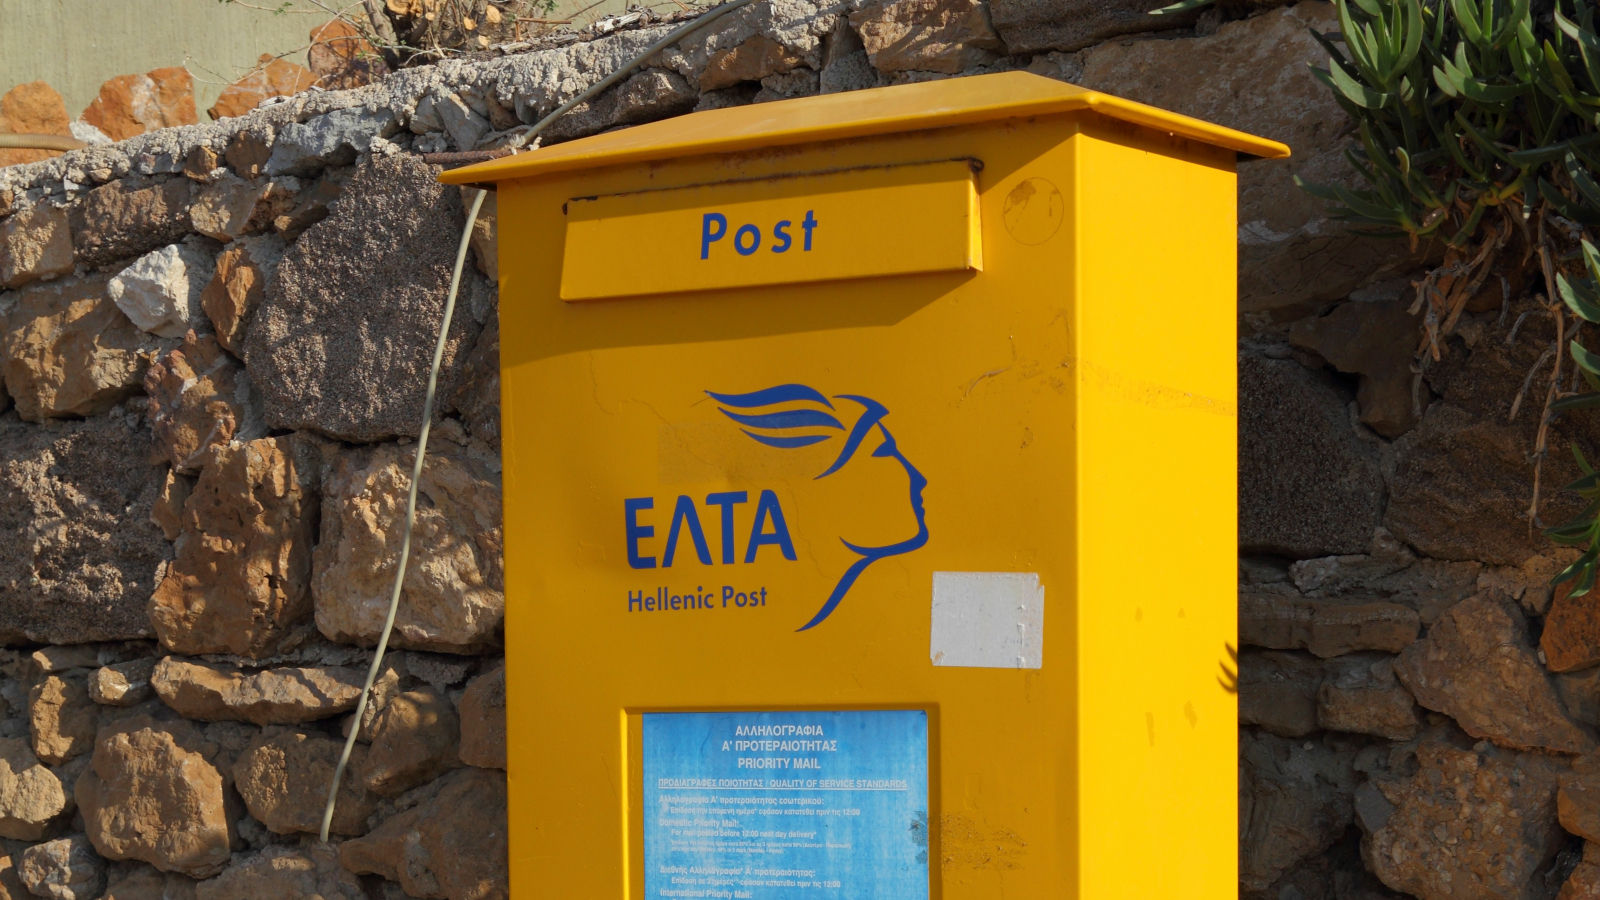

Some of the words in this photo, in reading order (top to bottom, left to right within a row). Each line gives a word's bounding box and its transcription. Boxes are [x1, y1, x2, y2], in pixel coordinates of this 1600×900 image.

[700, 209, 818, 260] Post
[624, 489, 798, 569] ΕΛΤΑ
[628, 586, 714, 612] Hellenic
[722, 585, 767, 608] Post
[735, 725, 823, 736] ΑΛΛΗΛΟΓΡΑΦΙΑ
[735, 740, 837, 751] ΠΡΟΤΕΡΑΙΟΤΗΤΑΣ
[738, 758, 790, 769] PRIORITY
[793, 758, 821, 769] MAIL
[718, 779, 763, 788] ΠΟΙΟΤΗΤΑΣ
[769, 779, 805, 789] QUALITY
[806, 779, 818, 788] OF
[819, 779, 855, 788] SERVICE
[856, 779, 908, 788] STANDARDS
